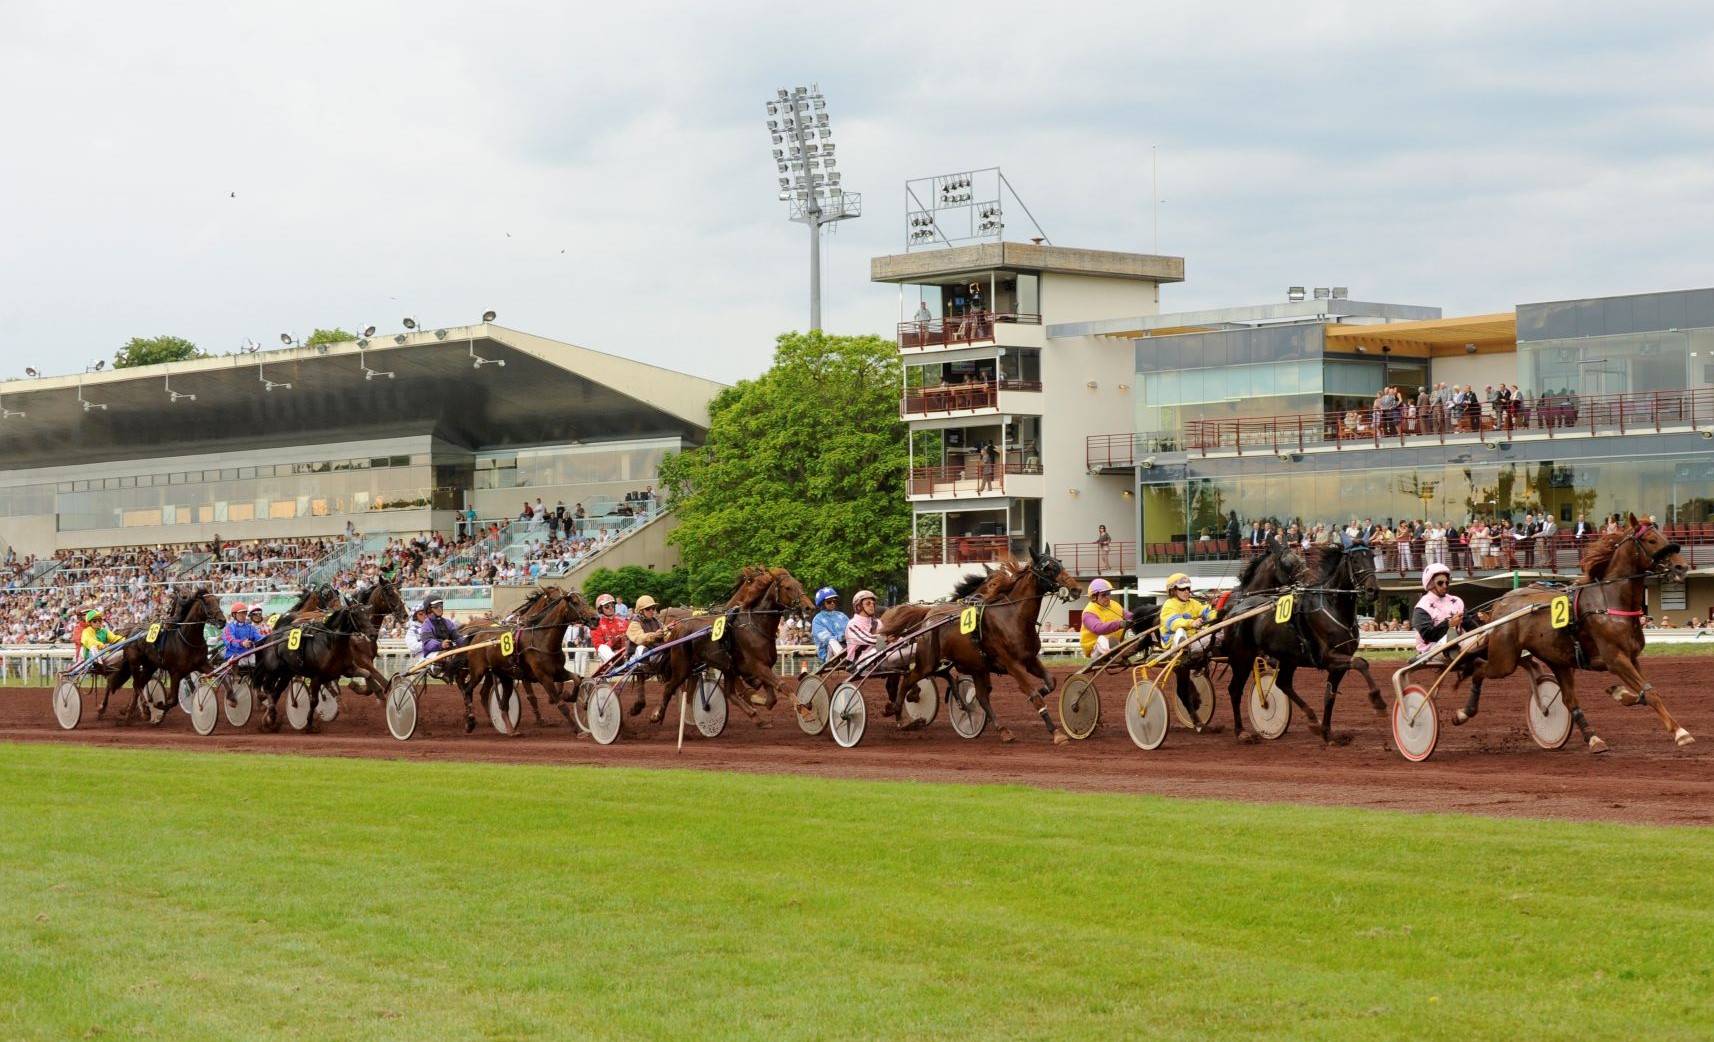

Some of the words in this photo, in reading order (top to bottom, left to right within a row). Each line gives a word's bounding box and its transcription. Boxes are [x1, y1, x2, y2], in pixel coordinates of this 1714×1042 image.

[1278, 598, 1291, 620] 10
[1555, 600, 1566, 624] 2
[714, 619, 723, 637] 3
[963, 610, 973, 629] 4
[290, 631, 299, 647] 5
[503, 635, 511, 652] 8
